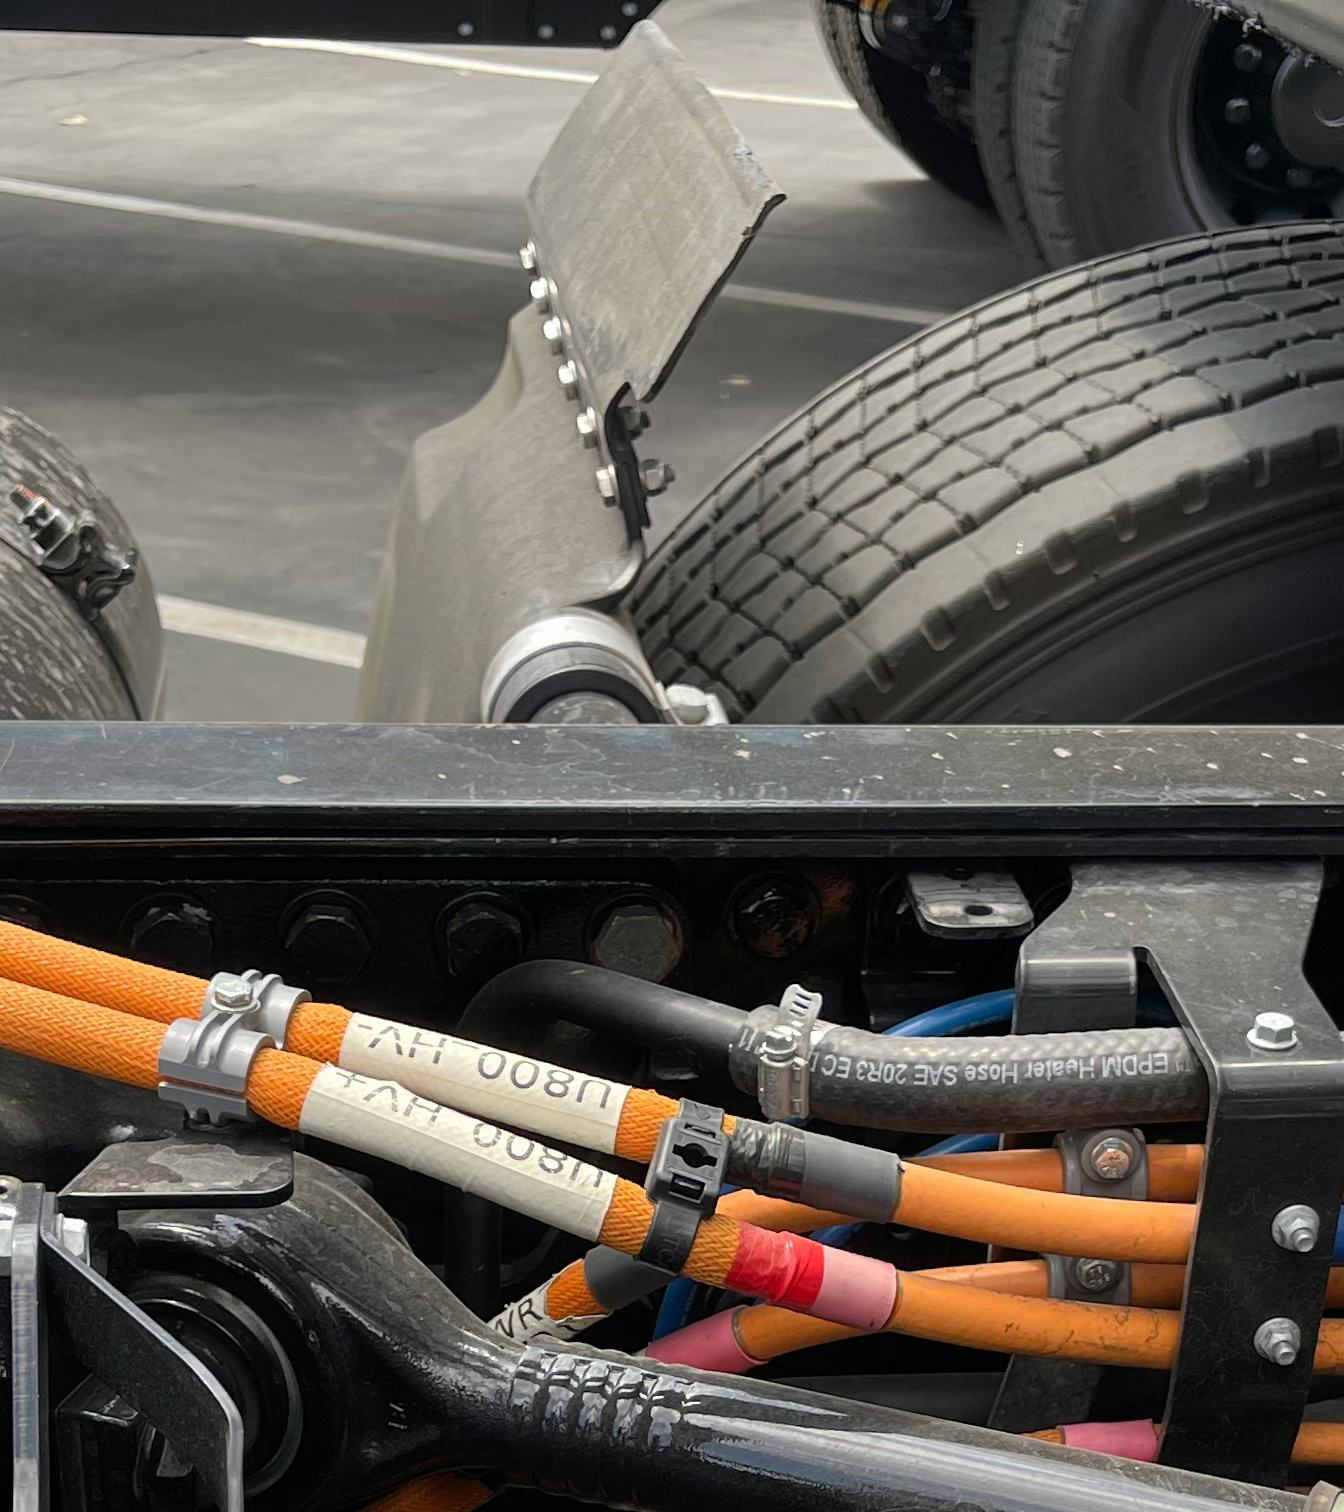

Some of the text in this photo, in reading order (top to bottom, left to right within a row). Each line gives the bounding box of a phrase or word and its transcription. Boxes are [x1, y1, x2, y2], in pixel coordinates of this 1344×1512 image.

[821, 1053, 852, 1080] EC
[856, 1059, 907, 1086] 20R3
[913, 1063, 958, 1087] SAE
[964, 1062, 1019, 1085] Hose
[1024, 1055, 1096, 1082] Heater
[1102, 1052, 1169, 1079] EPDM
